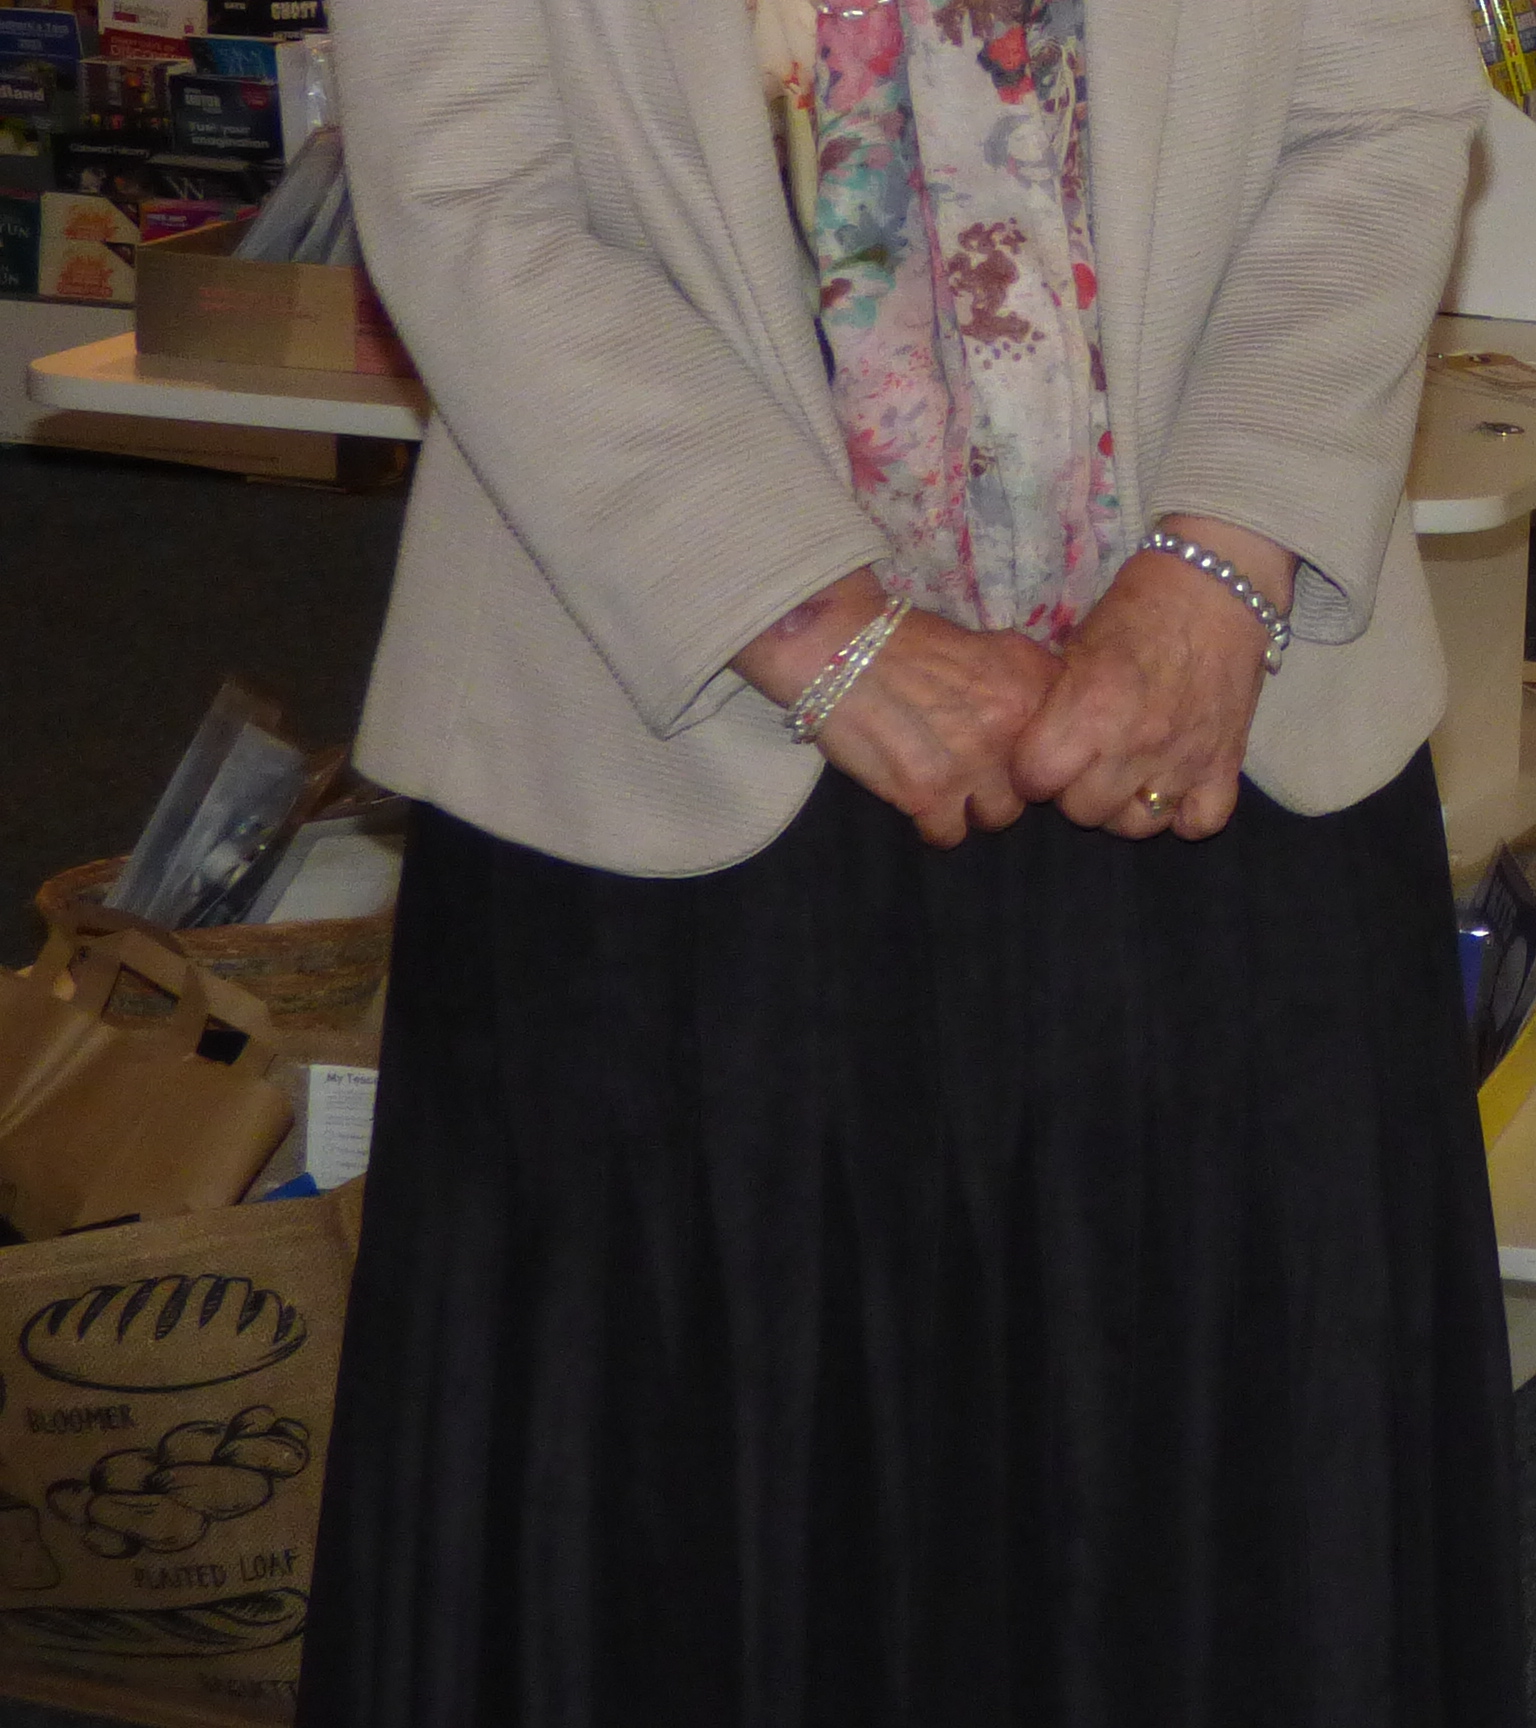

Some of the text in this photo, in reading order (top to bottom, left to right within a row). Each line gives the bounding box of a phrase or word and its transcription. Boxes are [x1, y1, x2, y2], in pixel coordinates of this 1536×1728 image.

[270, 0, 318, 21] GHOST
[192, 136, 272, 149] imagination
[222, 126, 251, 138] your
[27, 1405, 134, 1433] BLOOMER
[239, 1549, 300, 1582] LOAF
